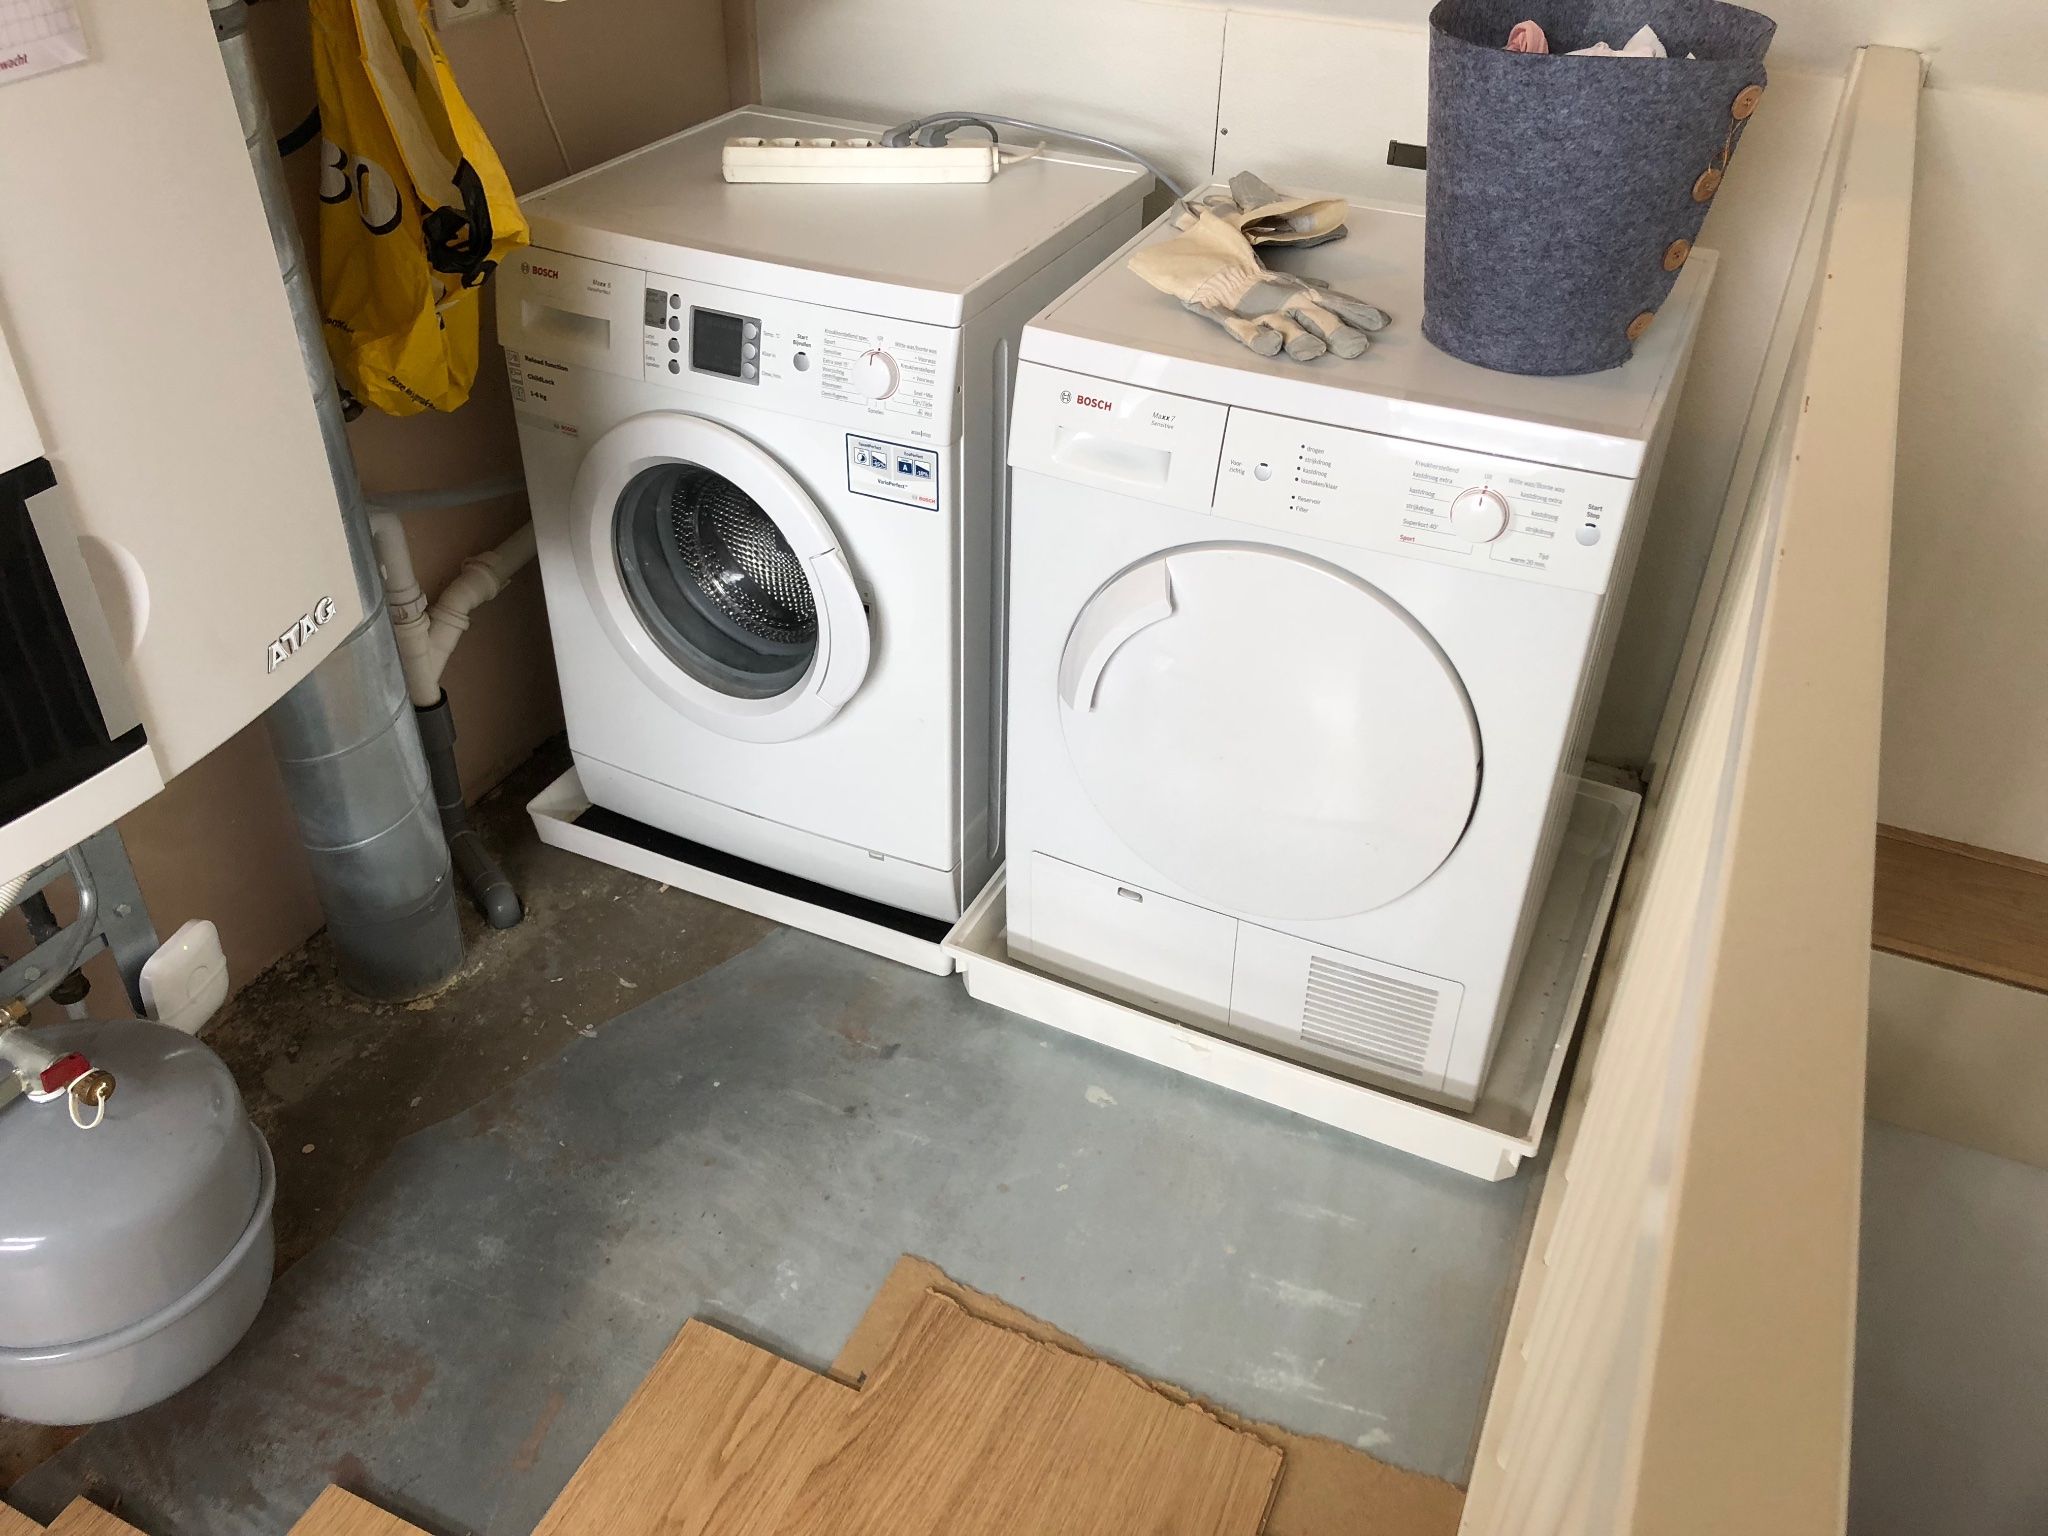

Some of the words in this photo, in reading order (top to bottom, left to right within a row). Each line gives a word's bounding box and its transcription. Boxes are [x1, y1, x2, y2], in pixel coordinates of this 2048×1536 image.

[532, 266, 559, 279] BOSCH
[797, 333, 809, 341] Start
[527, 373, 555, 385] ChildLock
[1077, 395, 1112, 412] BOSCH
[1152, 411, 1171, 422] Maxx
[1151, 420, 1175, 430] Sensitive
[1306, 446, 1325, 455] drogen
[1304, 456, 1332, 469] strijkdroog
[1302, 467, 1328, 479] kastdroog
[1412, 470, 1438, 483] kastdroog
[1439, 476, 1453, 484] extra
[1409, 487, 1436, 499] kastdroog
[1297, 494, 1321, 505] Reservoir
[1295, 504, 1309, 513] Filter
[1405, 502, 1435, 515] strijkdroog
[1587, 503, 1603, 512] Start
[1586, 511, 1601, 520] Stop
[1402, 517, 1429, 528] Superkort
[1399, 533, 1416, 543] Sport
[267, 595, 336, 674] ATAG
